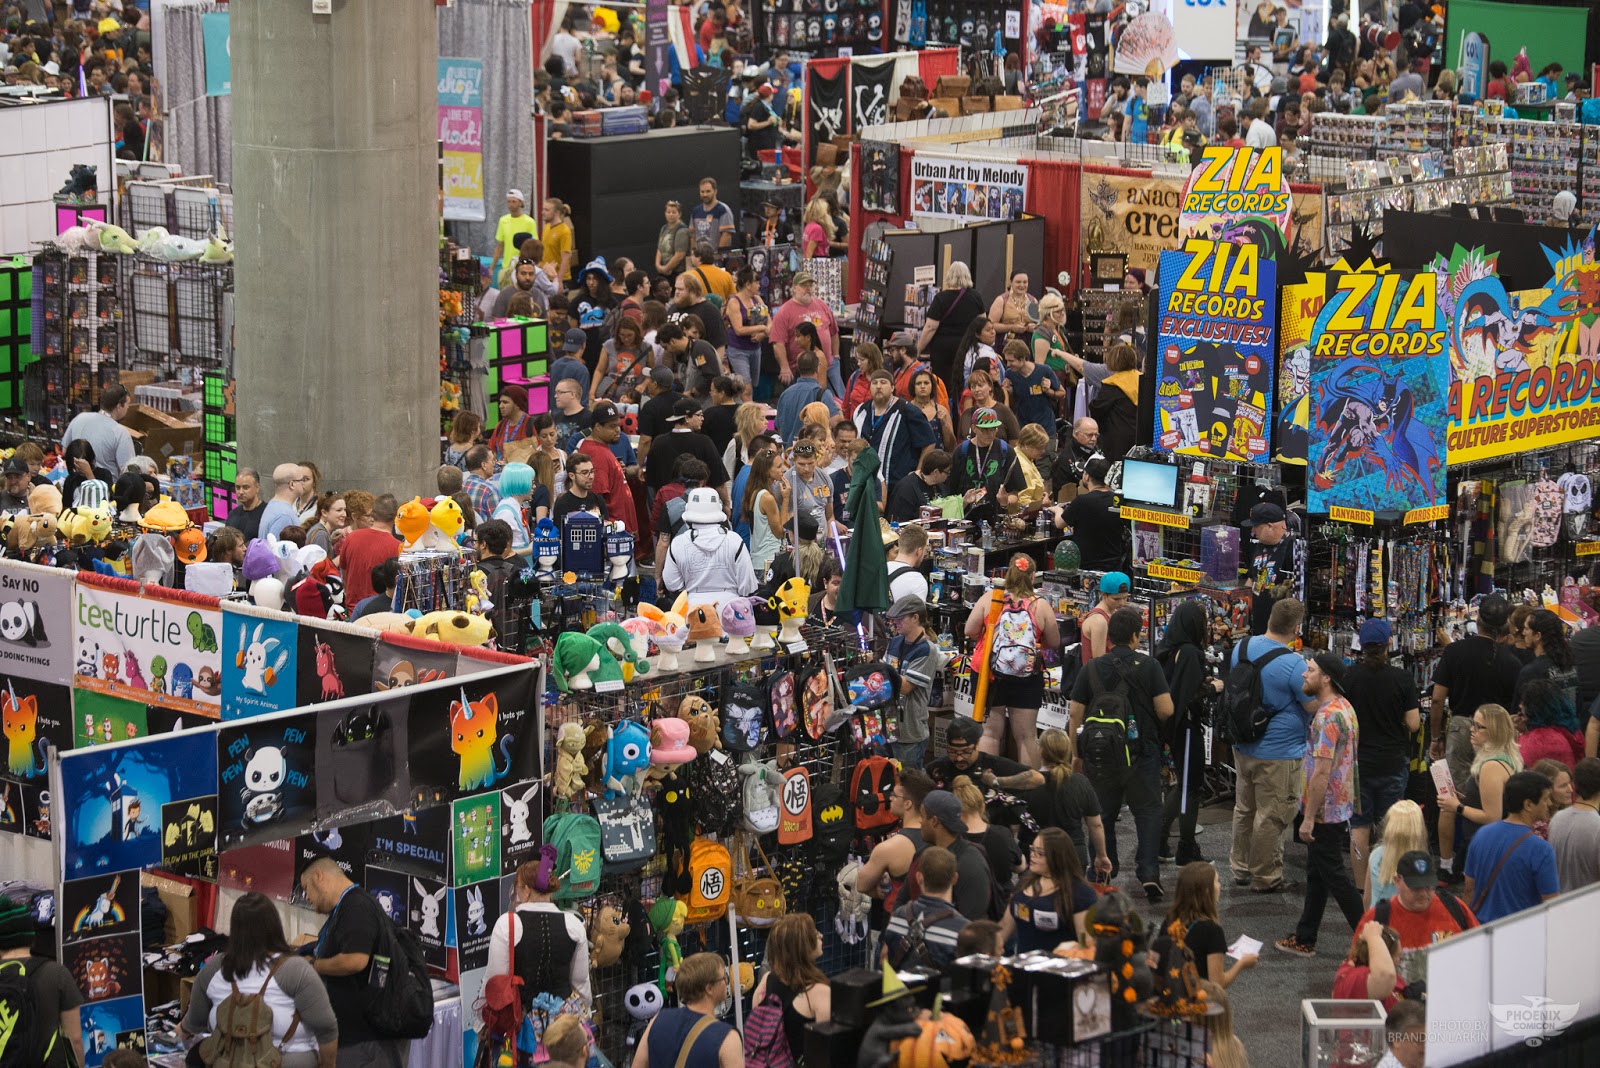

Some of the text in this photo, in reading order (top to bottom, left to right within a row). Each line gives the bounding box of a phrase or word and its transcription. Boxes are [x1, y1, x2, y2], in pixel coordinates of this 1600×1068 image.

[915, 162, 1024, 186] Urban Art by Melody
[1191, 146, 1282, 192] ZIA
[1182, 192, 1290, 214] RECORDS
[1142, 252, 1160, 262] JEW
[1176, 239, 1259, 296] ZIA
[1168, 292, 1264, 320] RECORDS
[1326, 272, 1436, 332] ZIA
[1160, 316, 1272, 346] EXCLUSIVES!
[1314, 332, 1446, 358] RECORDS
[1448, 422, 1509, 451] CULTURE
[1121, 506, 1188, 526] ZIA CON EXCLUSIVES!
[1331, 507, 1371, 522] LANYARDS
[1432, 506, 1449, 518] $7.99
[1149, 565, 1159, 574] ZIA
[1160, 566, 1174, 577] CON
[23, 580, 39, 593] NO
[79, 593, 181, 645] teeturtle
[4, 652, 25, 662] DOING
[26, 656, 50, 666] THINGS
[244, 697, 259, 706] Spirit
[260, 701, 279, 710] Animal
[502, 711, 515, 720] hate
[228, 732, 250, 758] PEW
[284, 728, 306, 744] PEW
[222, 760, 244, 784] PEW
[286, 770, 309, 788] PEW
[786, 779, 806, 809] 悟
[376, 837, 444, 863] I'M SPECIAL!
[522, 840, 535, 849] EARLY
[164, 856, 180, 865] GLOW
[189, 852, 199, 860] THE
[703, 872, 721, 895] 悟
